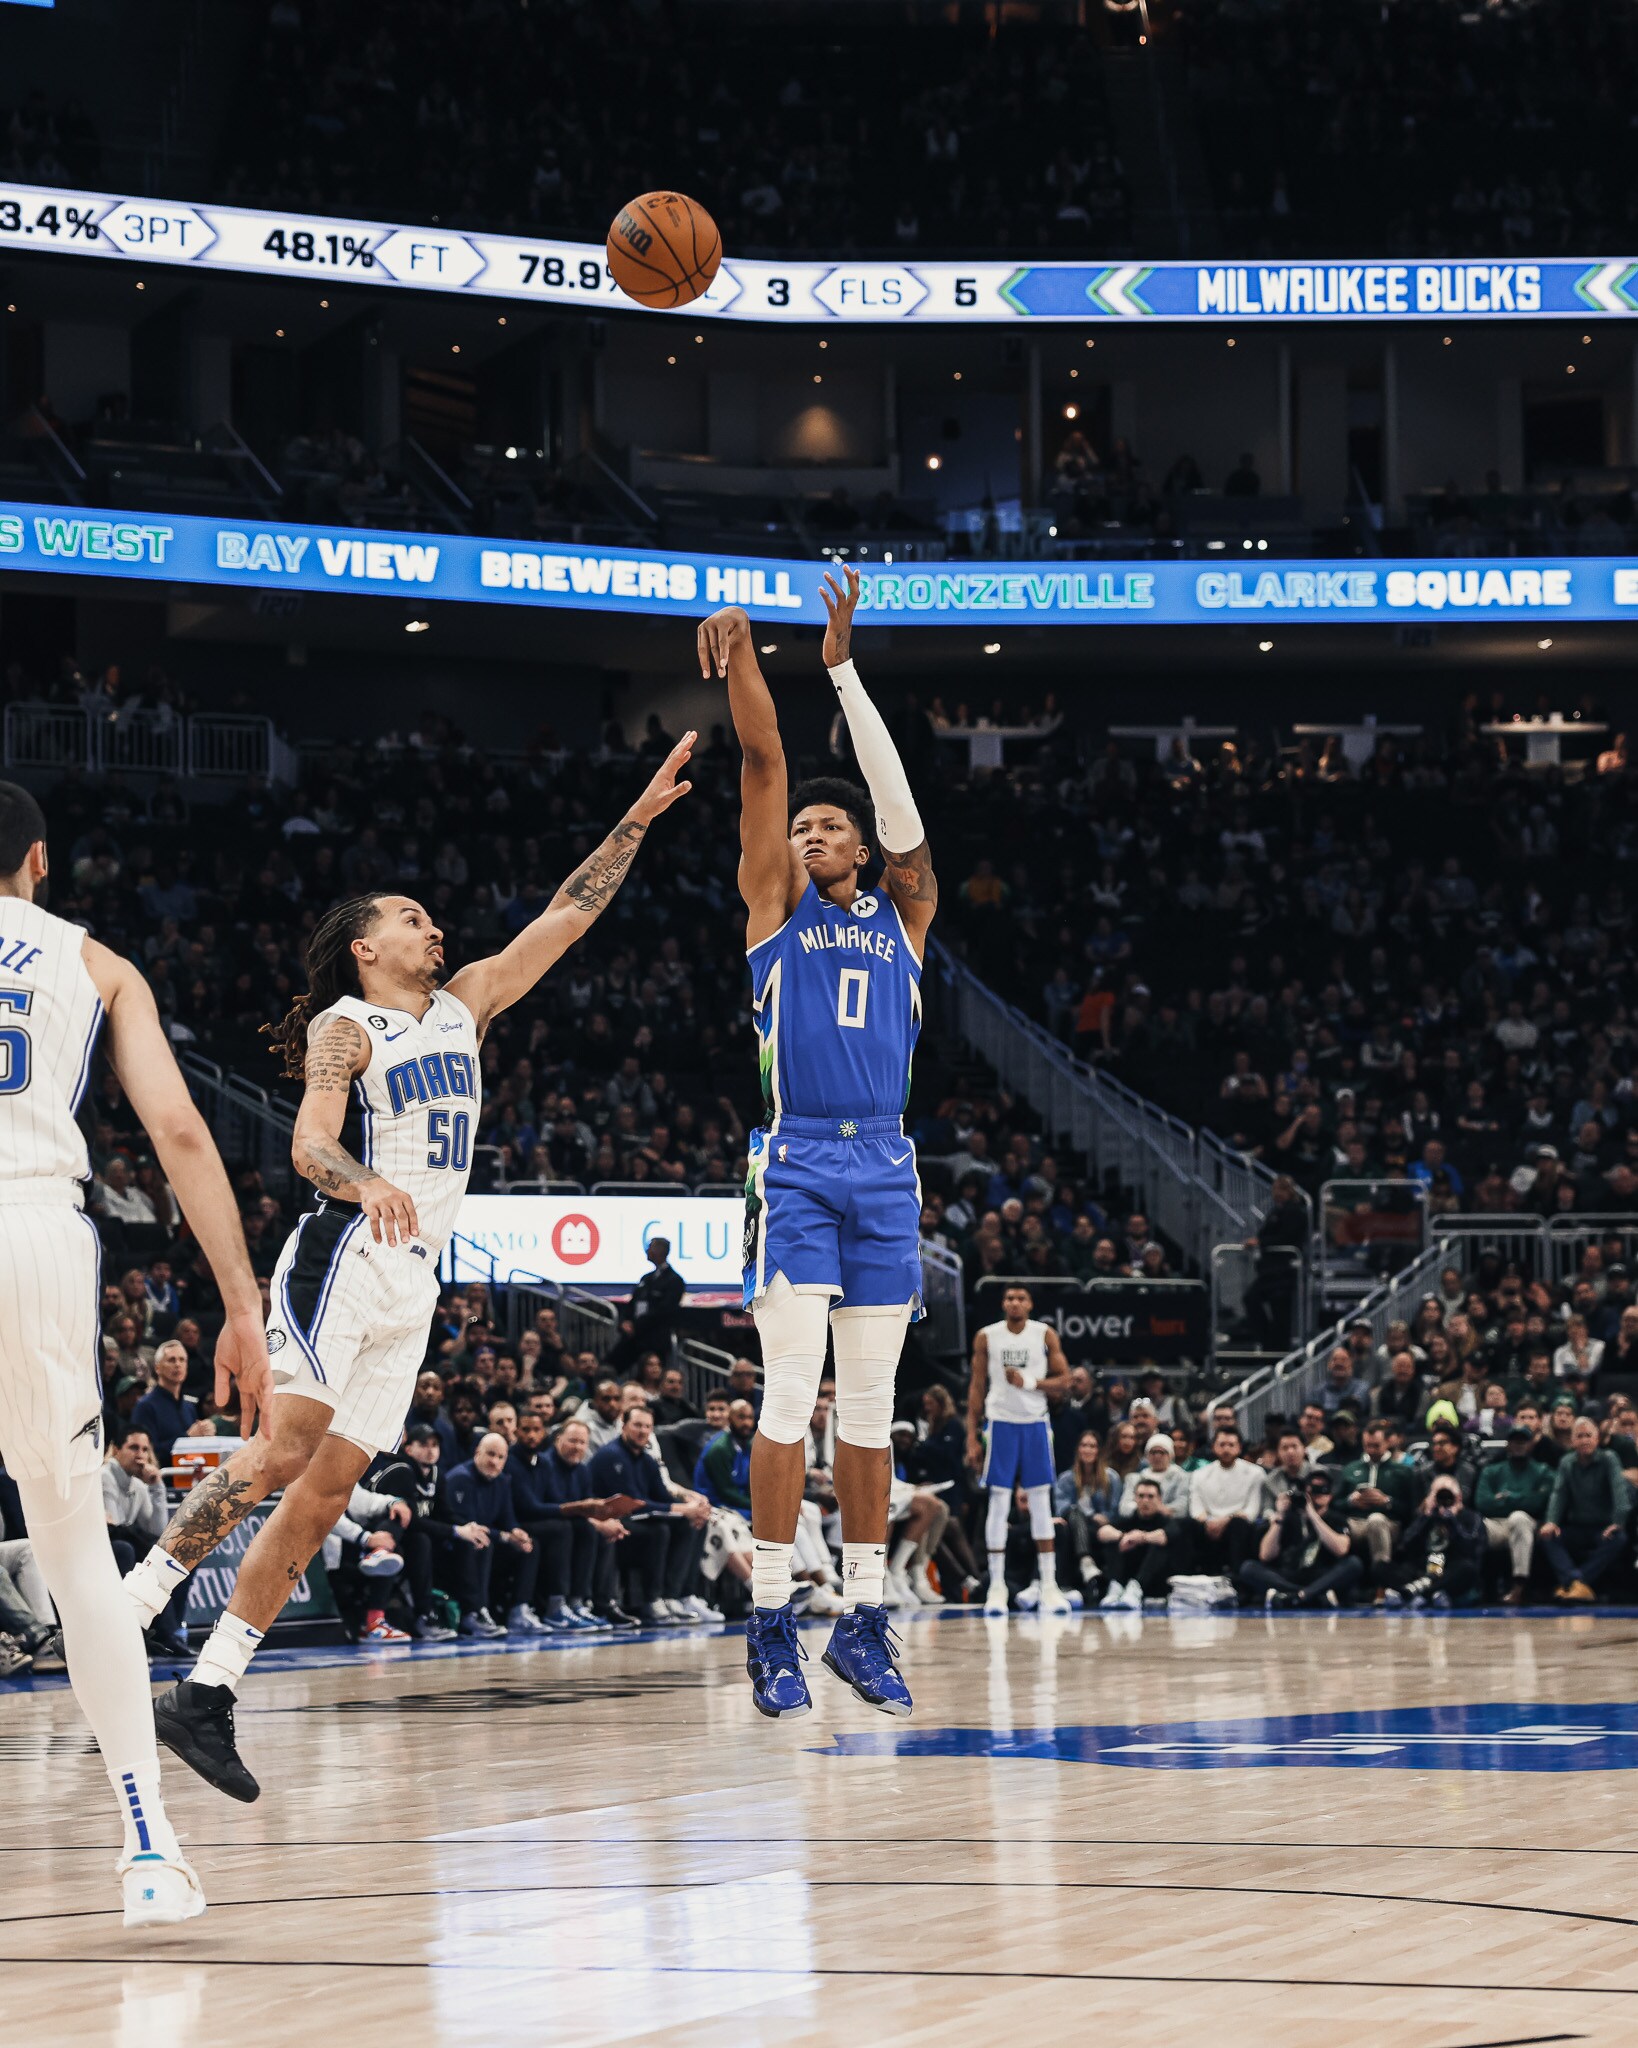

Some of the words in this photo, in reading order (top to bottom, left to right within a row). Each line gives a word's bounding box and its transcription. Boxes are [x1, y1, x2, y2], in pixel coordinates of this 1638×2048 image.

[124, 214, 192, 247] 3PT
[263, 229, 374, 268] 48.1%
[411, 244, 449, 272] FT
[767, 278, 789, 306] 3
[841, 279, 902, 305] FLS
[955, 278, 977, 306] 5
[1198, 267, 1408, 313] MILWAUKEE
[1416, 266, 1541, 312] BUCKS
[33, 517, 174, 563] WEST
[217, 531, 311, 573] BAY
[316, 538, 440, 582] VIEW
[481, 550, 698, 600] BREWERS
[706, 566, 802, 608] HILL
[843, 573, 1154, 609] BRONZEVILLE
[1196, 571, 1378, 608] CLARKE
[1386, 570, 1572, 610] SQUARE
[0, 936, 43, 975] ZE
[369, 1015, 387, 1030] 6
[837, 968, 869, 1029] 0
[385, 1052, 477, 1116] MAGI
[427, 1109, 469, 1171] 50
